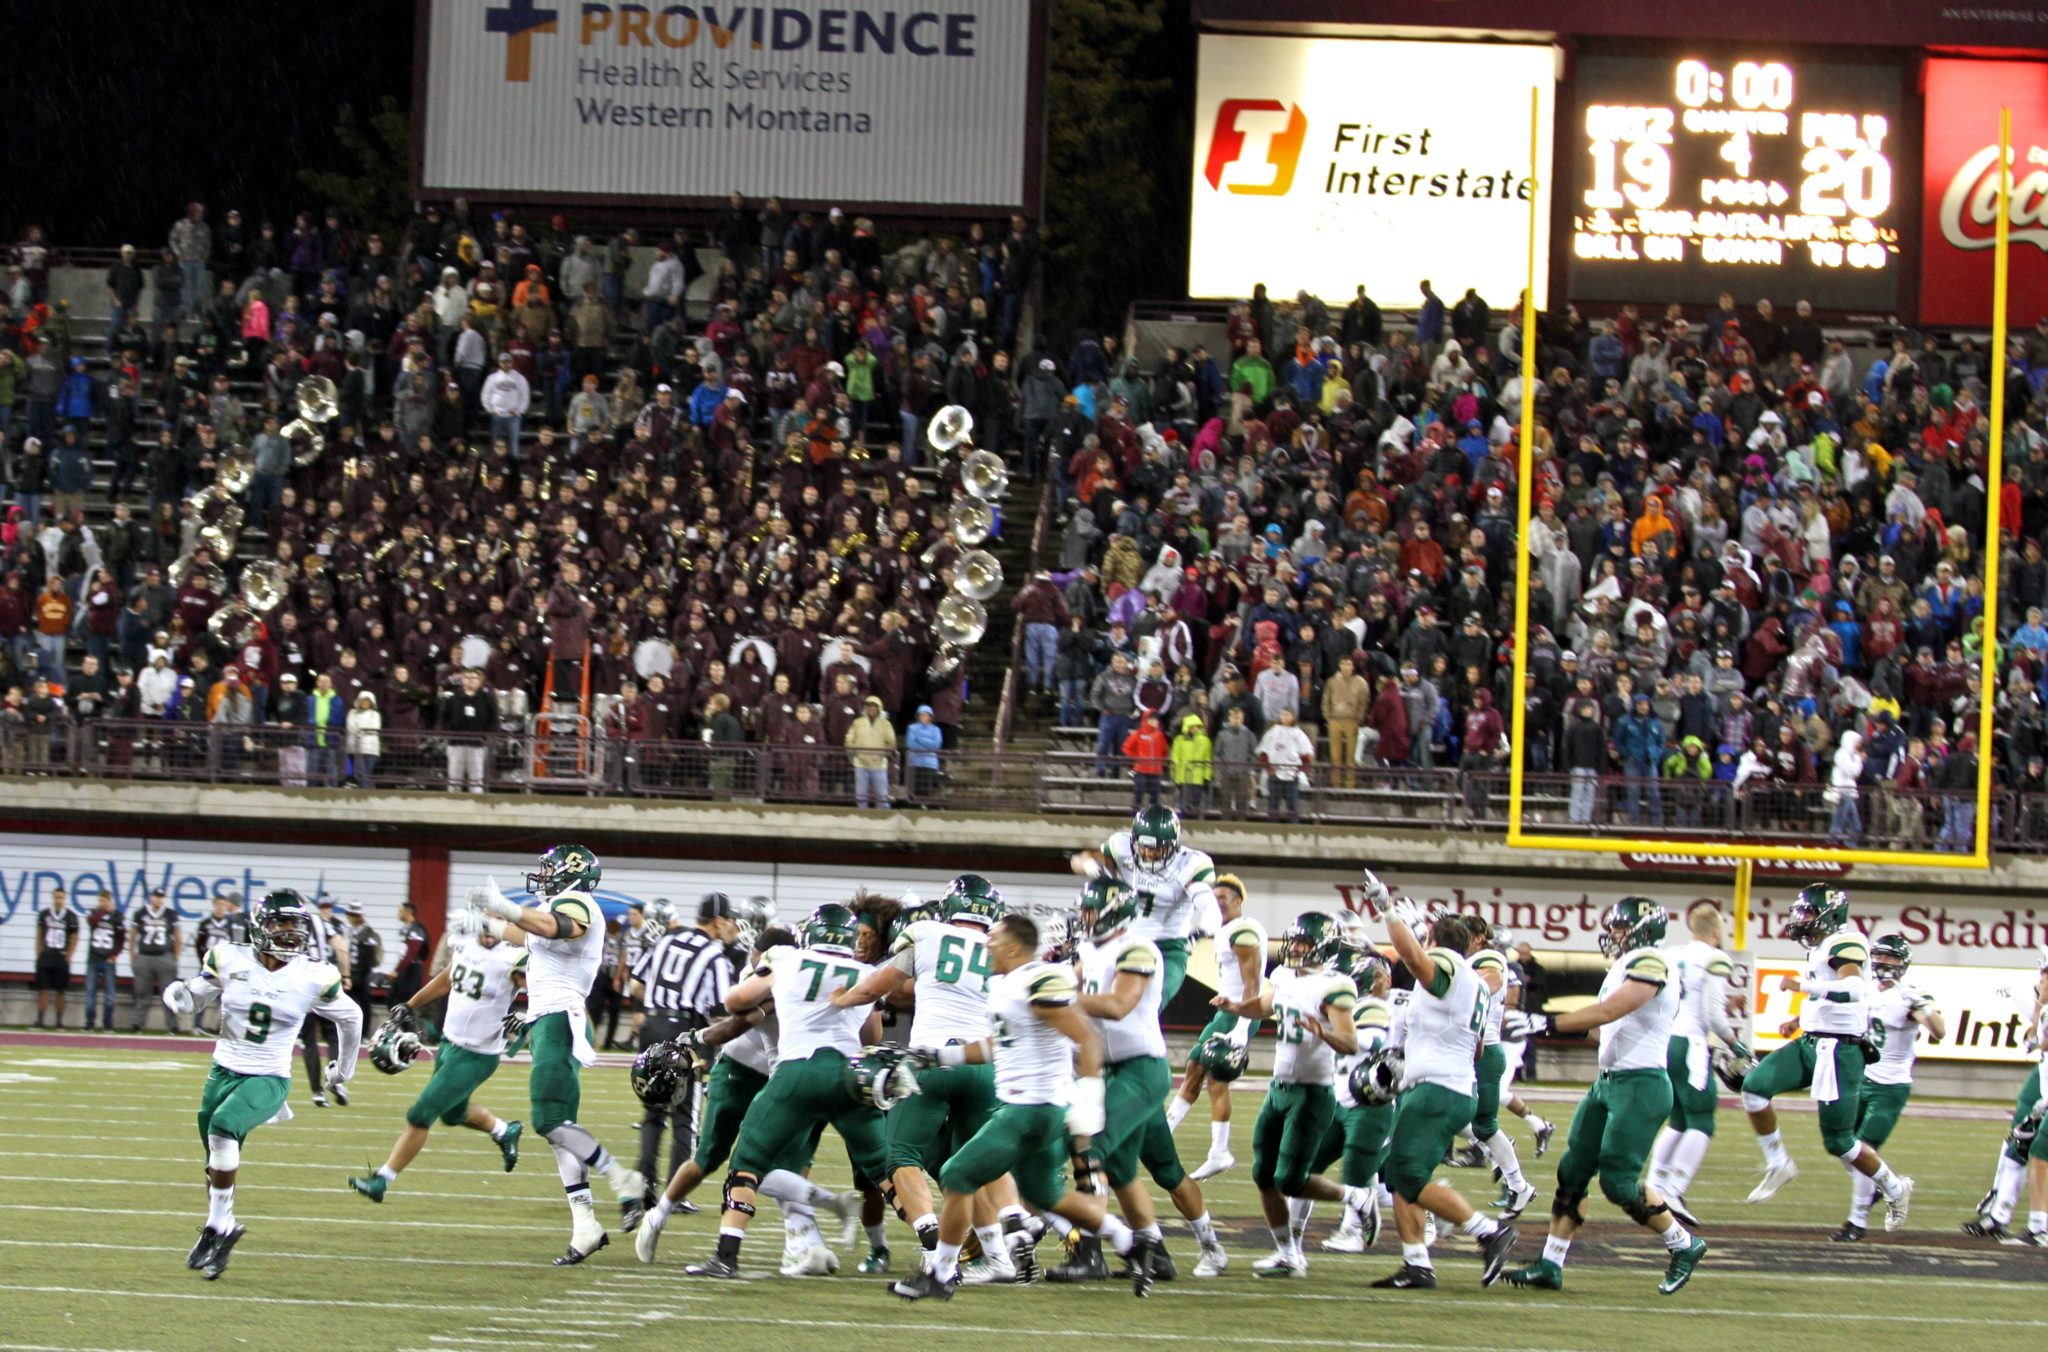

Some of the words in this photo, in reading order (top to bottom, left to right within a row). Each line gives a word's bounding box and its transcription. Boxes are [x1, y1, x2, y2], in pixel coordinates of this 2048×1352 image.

[580, 3, 976, 56] PROVIDENCE
[577, 57, 682, 88] Health
[690, 59, 714, 87] &
[723, 61, 851, 94] Services
[574, 97, 712, 129] Western
[725, 102, 872, 135] Montana
[1333, 123, 1432, 156] First
[1325, 161, 1539, 200] Interstate
[1584, 141, 1670, 210] 19
[1800, 146, 1891, 218] 20
[143, 926, 167, 946] 73
[452, 964, 484, 1000] 83
[936, 934, 993, 992] 64
[245, 1002, 272, 1045] 9
